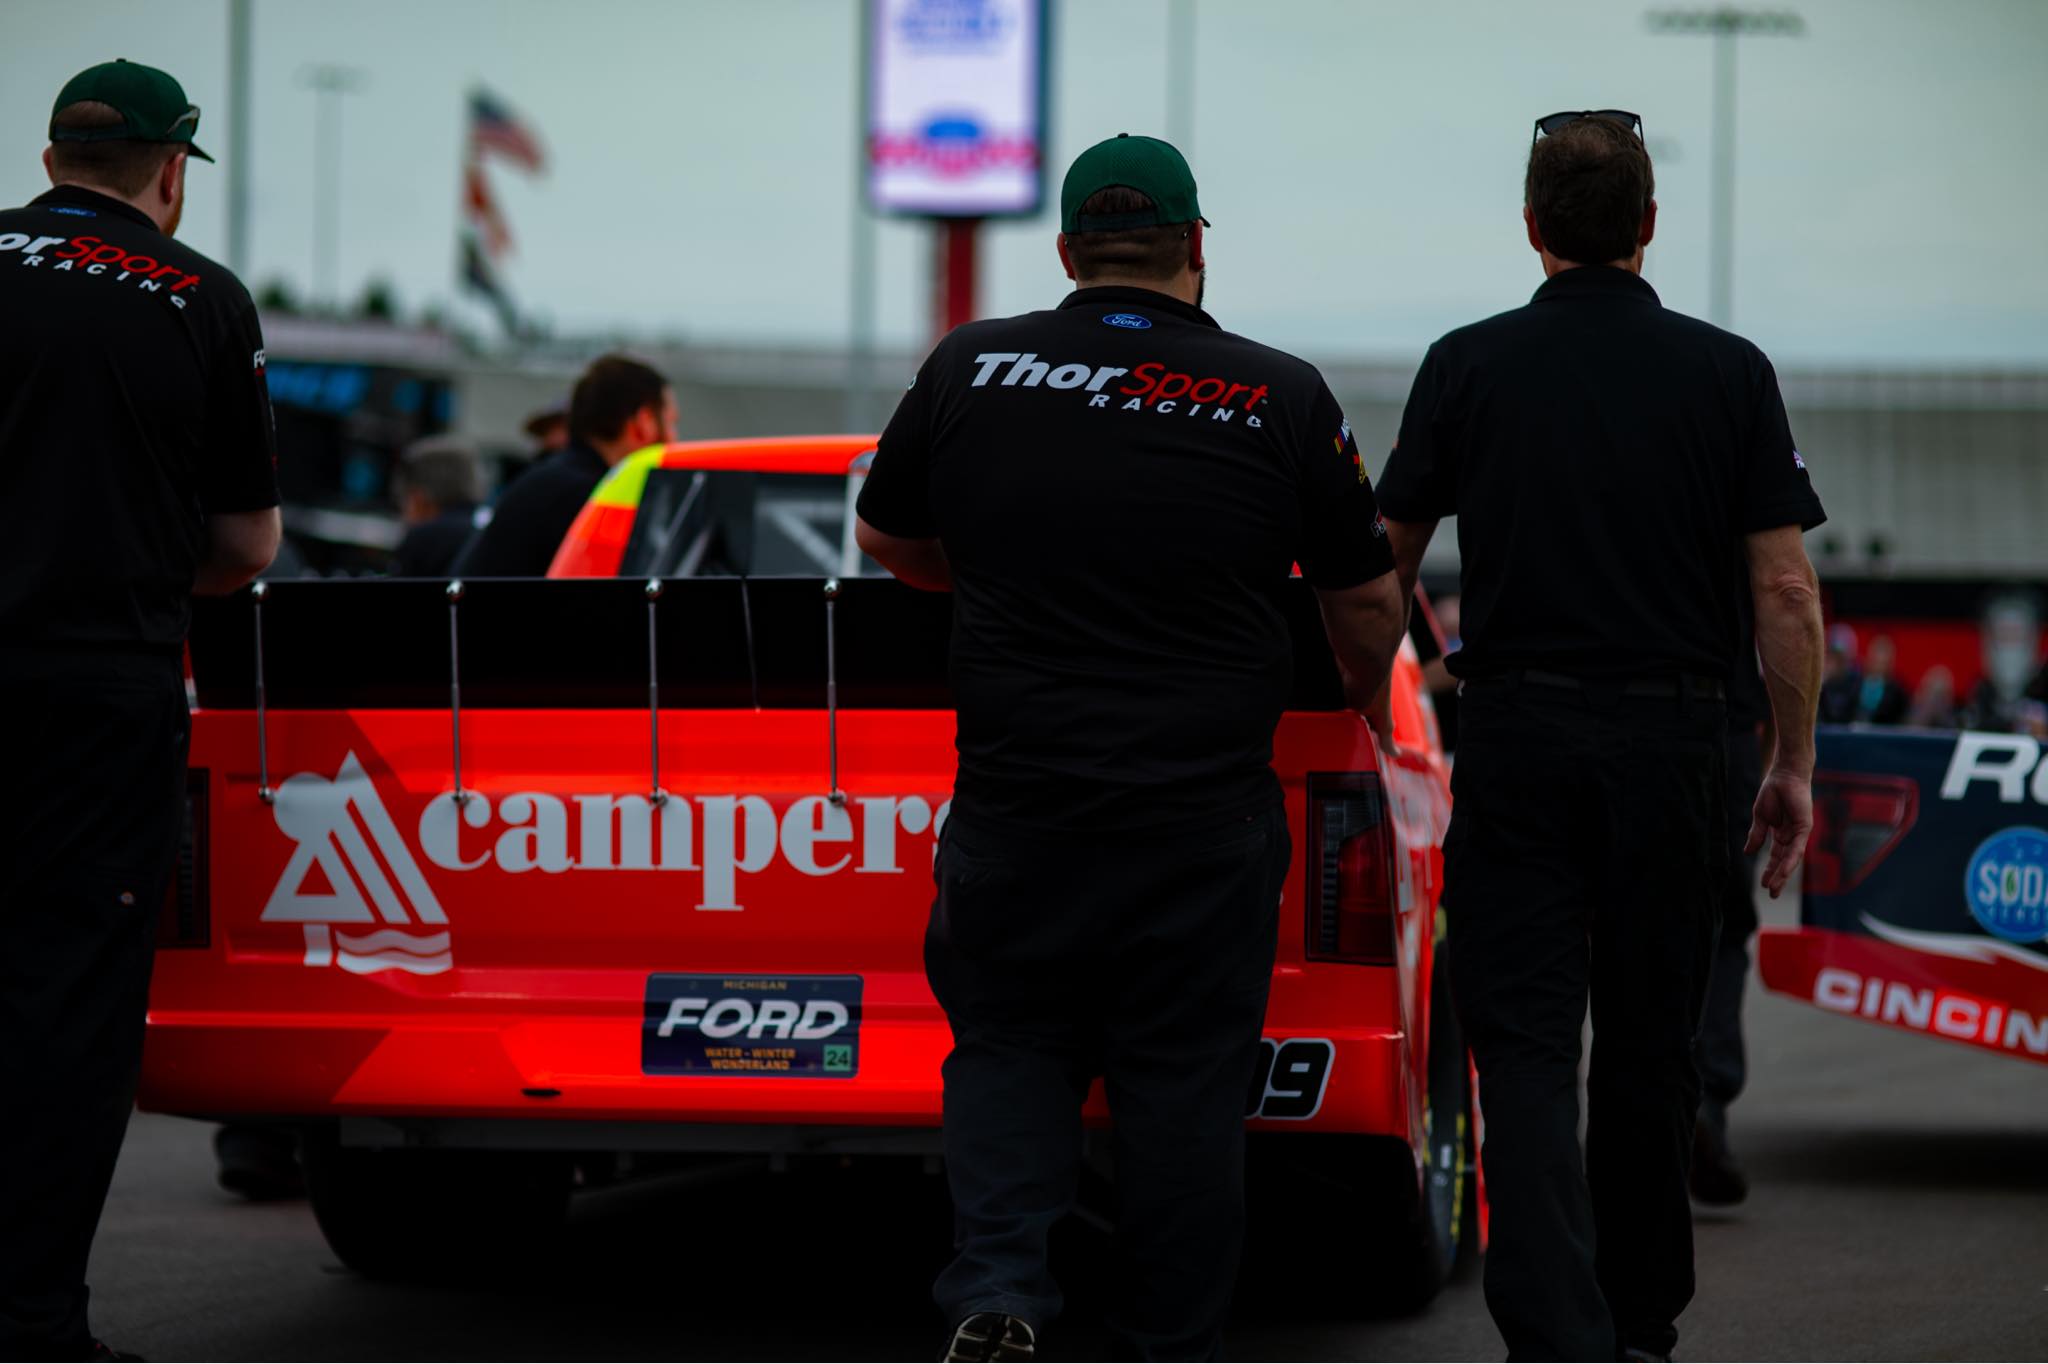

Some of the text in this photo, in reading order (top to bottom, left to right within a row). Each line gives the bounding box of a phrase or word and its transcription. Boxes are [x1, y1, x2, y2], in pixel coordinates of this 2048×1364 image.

[22, 254, 188, 310] RACING
[1110, 313, 1145, 329] Ford
[970, 352, 1270, 413] ThorSport
[1089, 393, 1264, 428] RACING
[418, 789, 952, 911] camper
[1976, 862, 2048, 907] SOD
[723, 980, 788, 991] MICHIGAN
[657, 997, 849, 1039] FORD
[826, 1050, 849, 1067] 24
